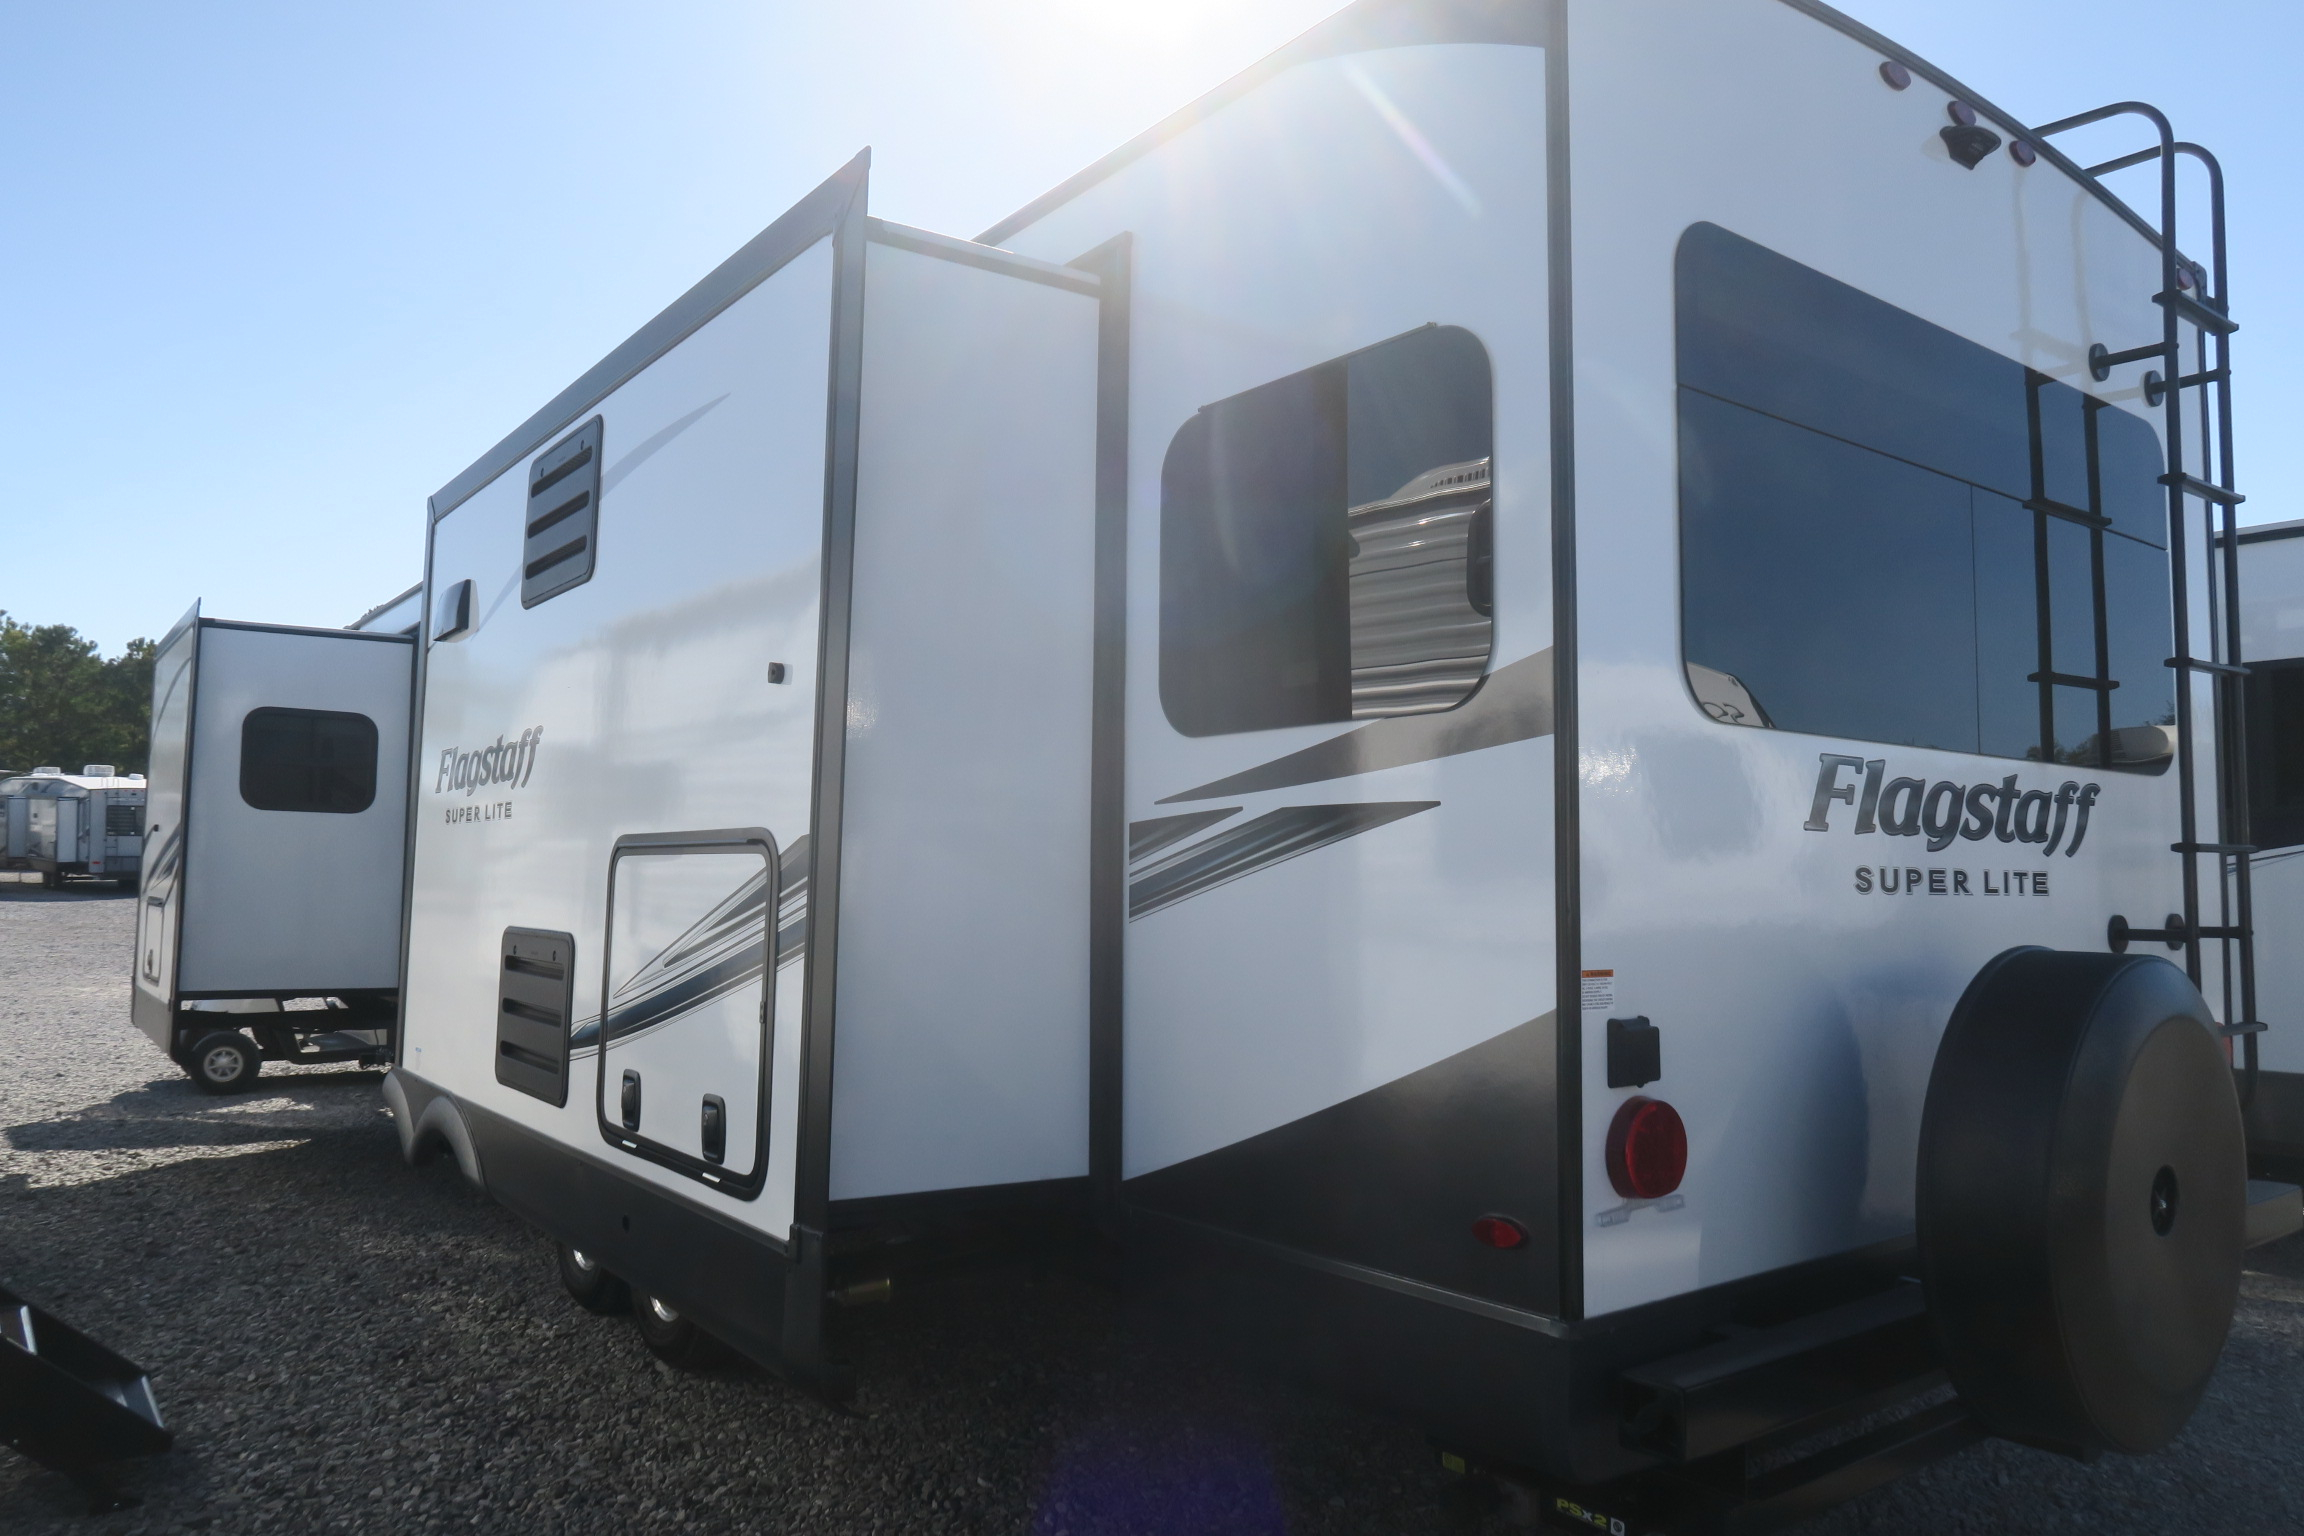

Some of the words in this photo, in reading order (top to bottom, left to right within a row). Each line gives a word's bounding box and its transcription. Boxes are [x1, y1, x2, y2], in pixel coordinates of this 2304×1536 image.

[435, 724, 544, 797] Flagstaff
[445, 805, 481, 825] SUPER
[484, 801, 513, 821] LITE
[1803, 753, 2101, 857] Flagstaff
[1854, 865, 1973, 895] SUPER
[1983, 868, 2050, 896] LITE
